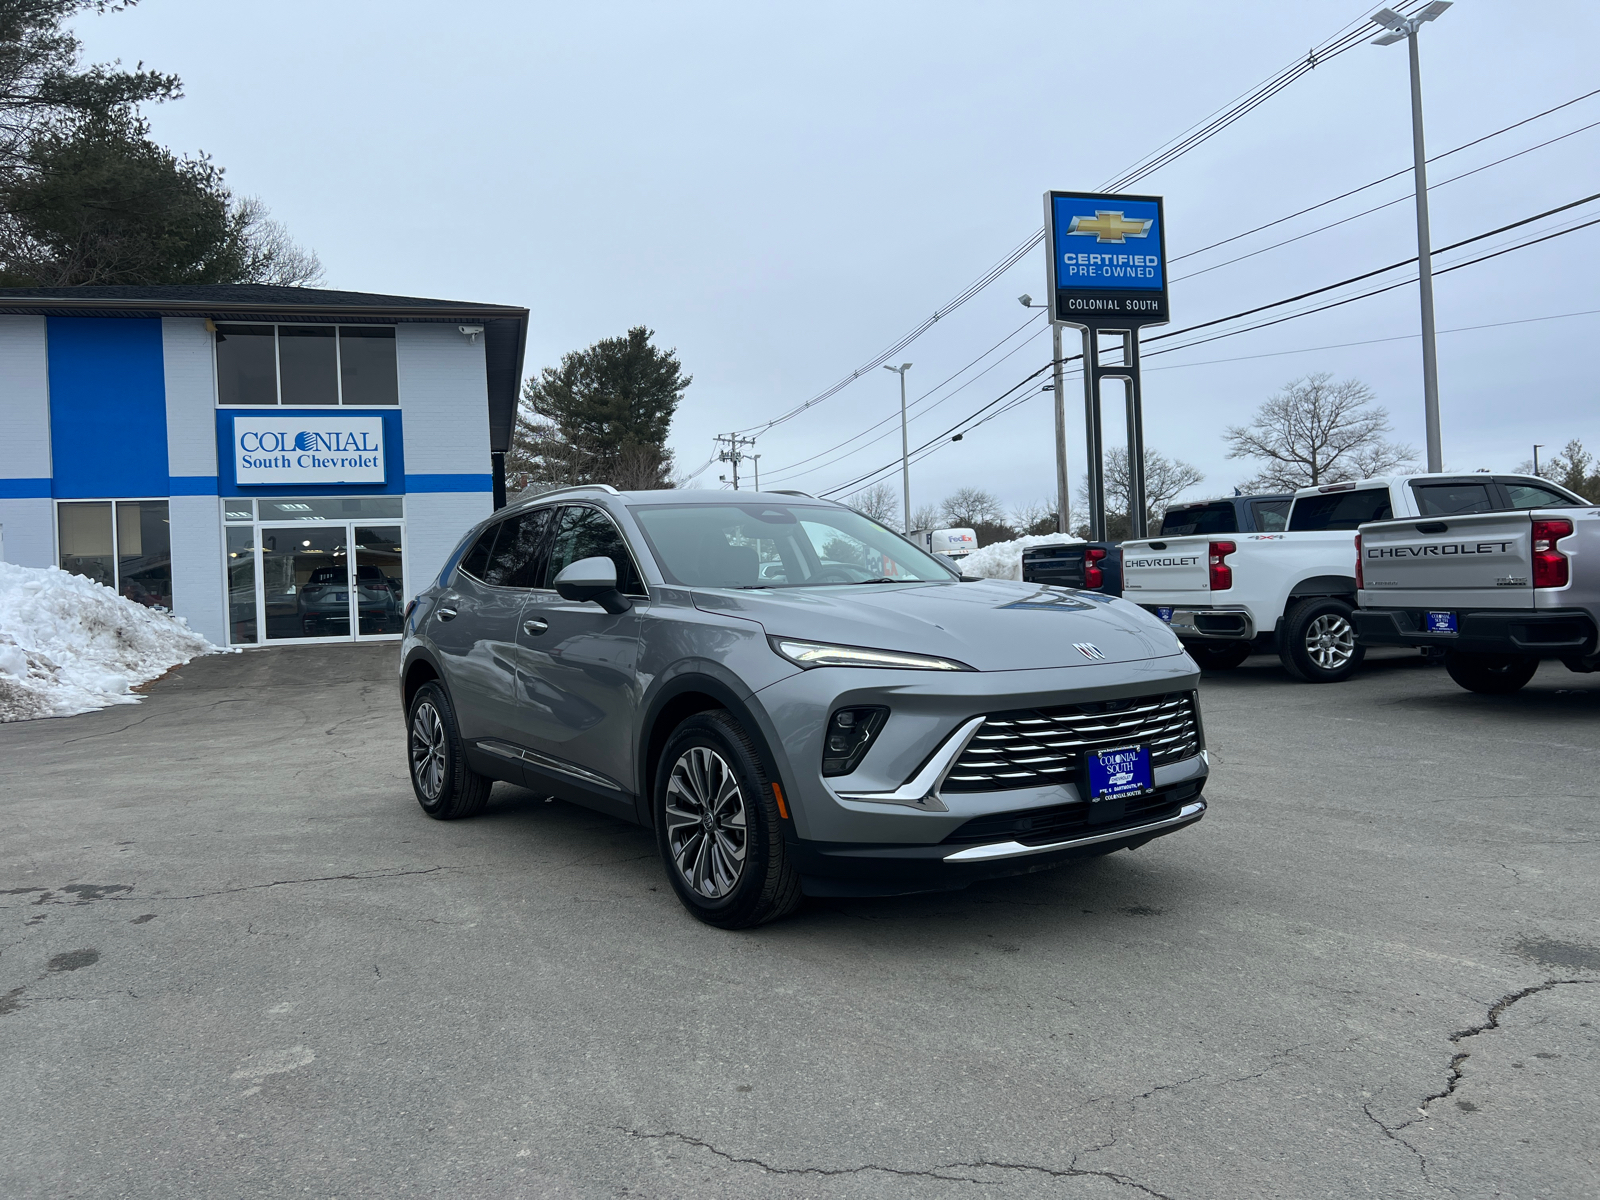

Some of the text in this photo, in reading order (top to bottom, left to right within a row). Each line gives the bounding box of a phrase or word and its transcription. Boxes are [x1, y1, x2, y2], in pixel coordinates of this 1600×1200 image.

[1064, 253, 1158, 267] CERTIFIED
[1069, 266, 1155, 278] PRE-OWNED
[1069, 299, 1159, 310] COLONIAL SOUTH
[240, 431, 379, 452] COLONIAL
[242, 454, 379, 469] South Chevrolet
[948, 534, 973, 543] FedEx
[1368, 541, 1513, 559] CHEVROLET
[1125, 556, 1199, 568] CHEVROLET
[1100, 752, 1138, 766] COLONIAL
[1106, 761, 1134, 775] SOUTH
[1105, 792, 1127, 801] COLONIAL
